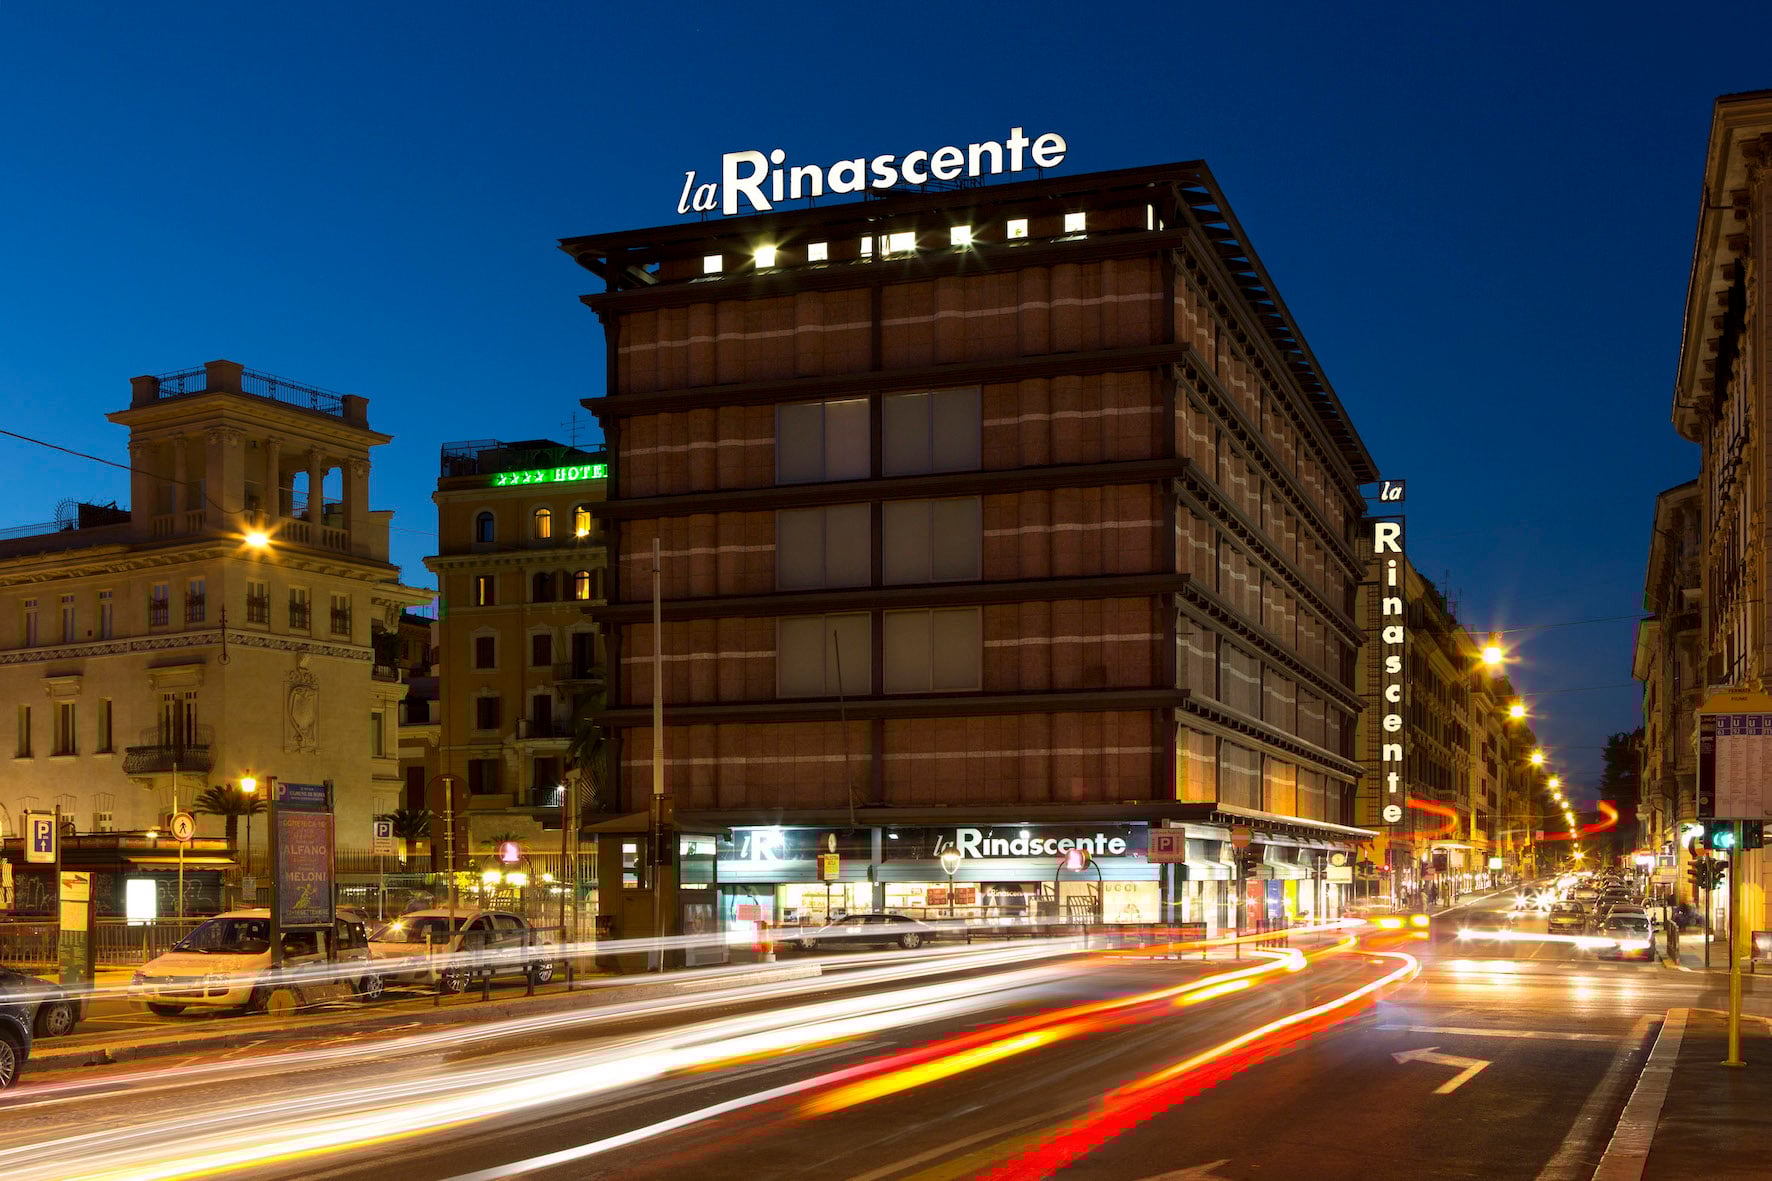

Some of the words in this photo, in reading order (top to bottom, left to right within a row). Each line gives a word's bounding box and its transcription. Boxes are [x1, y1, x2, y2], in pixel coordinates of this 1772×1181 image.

[677, 171, 718, 214] la
[722, 126, 1067, 216] Rinascente
[1380, 481, 1403, 501] la
[37, 823, 49, 840] P
[379, 824, 388, 836] P
[283, 845, 327, 855] ALFANO
[956, 828, 1127, 859] Rinascente
[1160, 838, 1171, 851] P
[286, 871, 327, 881] MELONI
